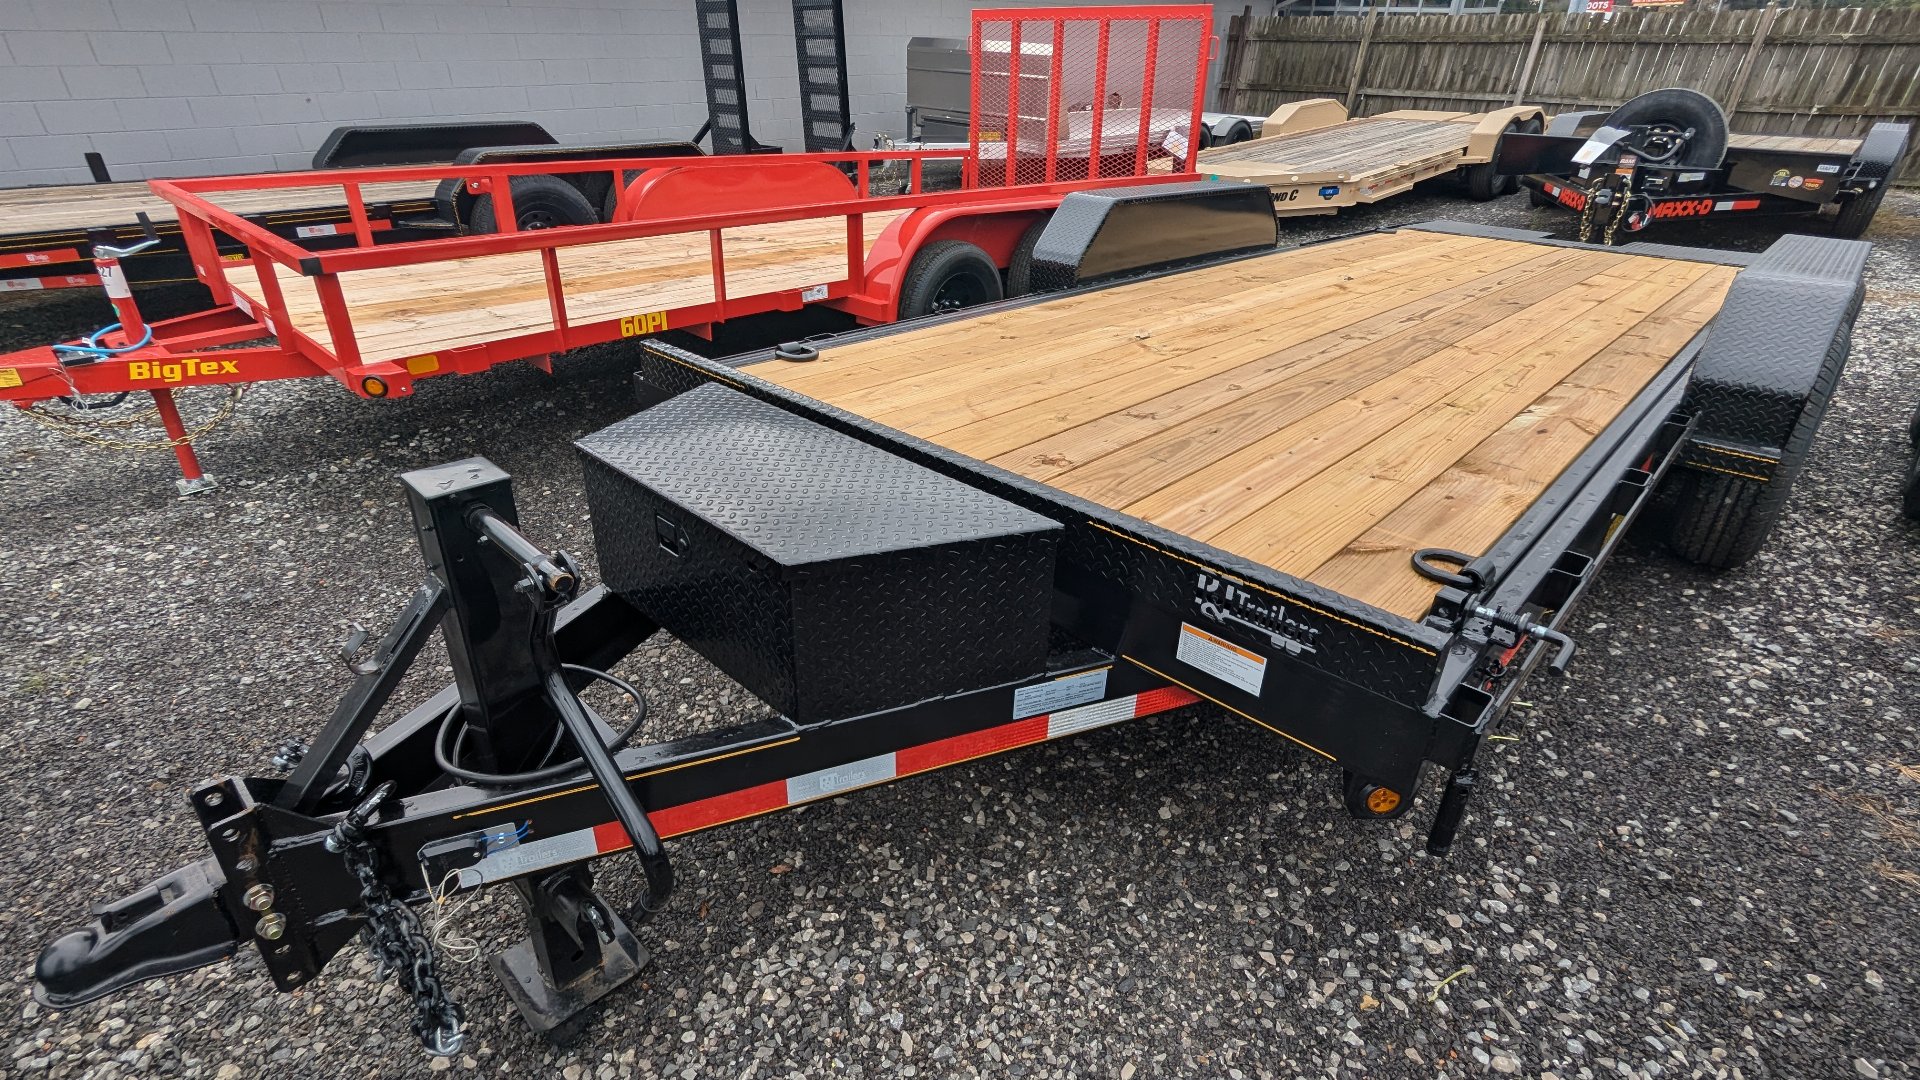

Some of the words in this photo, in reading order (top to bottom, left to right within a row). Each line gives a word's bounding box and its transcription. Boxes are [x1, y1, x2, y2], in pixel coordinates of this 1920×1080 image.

[1289, 189, 1299, 201] C
[1648, 199, 1713, 218] MAXX-D
[1236, 589, 1320, 649] Trailers
